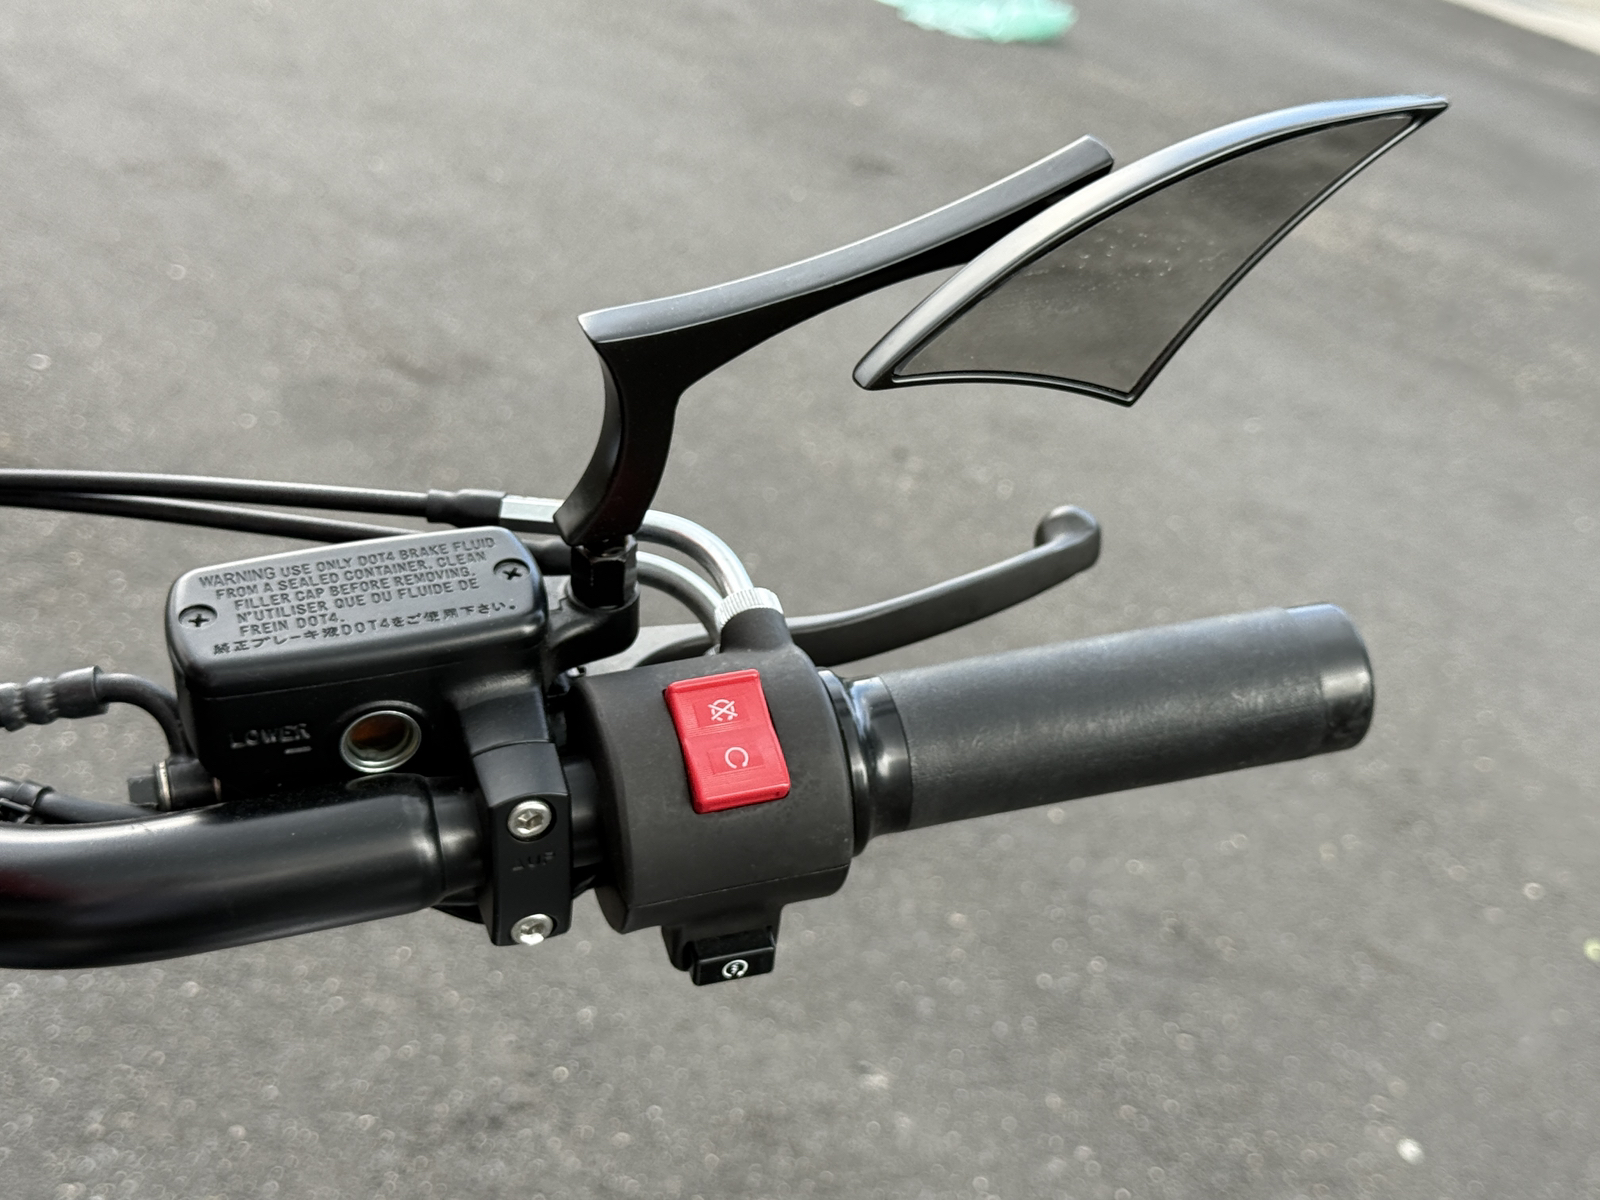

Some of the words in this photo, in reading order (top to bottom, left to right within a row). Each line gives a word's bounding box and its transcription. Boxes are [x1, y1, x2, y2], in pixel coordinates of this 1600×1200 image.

[199, 567, 276, 588] WARNING
[280, 563, 311, 578] USE
[316, 557, 353, 573] ONLY
[357, 551, 396, 567] DOT4
[400, 543, 449, 561] BRAKE
[452, 537, 496, 553] FLUID
[216, 584, 259, 600] FROM
[263, 582, 274, 593] A
[278, 571, 339, 591] SEALED
[344, 559, 433, 581] CONTAINER.
[437, 551, 487, 569] CLEAN
[234, 593, 292, 611] FILLER
[295, 588, 325, 602] CAP
[329, 578, 390, 597] BEFORE
[394, 566, 476, 588] REMOVING.
[236, 601, 329, 624] N'UTILISER
[334, 594, 366, 609] QUE
[371, 591, 393, 604] DU
[398, 580, 453, 600] FLUIDE
[458, 578, 480, 591] DE
[240, 619, 290, 637] FREIN
[296, 612, 346, 629] DOT4.
[230, 723, 311, 749] LOWER
